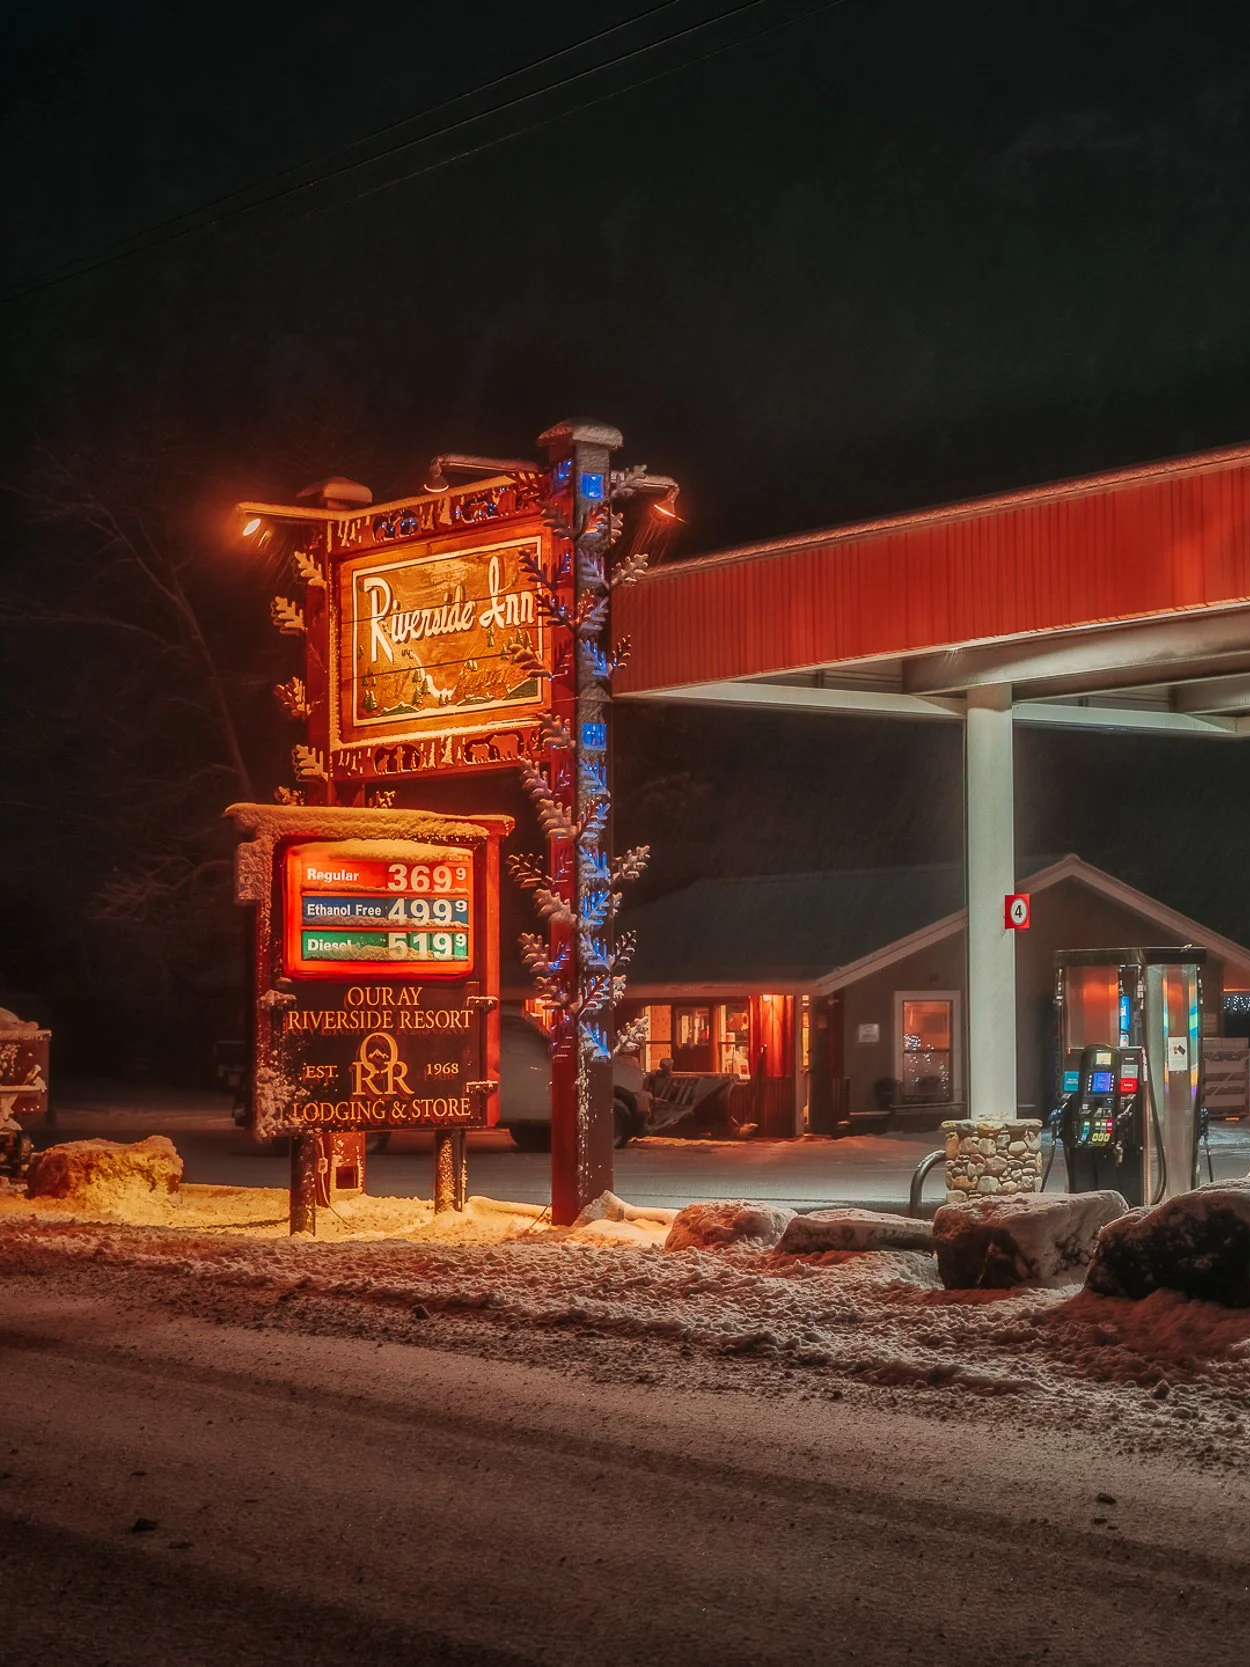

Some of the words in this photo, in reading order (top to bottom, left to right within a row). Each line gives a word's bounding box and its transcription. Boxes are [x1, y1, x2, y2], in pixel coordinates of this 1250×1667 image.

[363, 577, 477, 663] Riverside
[479, 556, 535, 629] Inn
[306, 867, 360, 883] Regular
[307, 904, 351, 916] Ethanol
[355, 904, 382, 916] Free
[1014, 904, 1023, 919] 4
[347, 986, 424, 1006] OURAY
[287, 1010, 394, 1030] RIVERSIDE
[399, 1009, 474, 1029] RESORT
[305, 1065, 339, 1079] EST.
[426, 1062, 460, 1075] 1968
[293, 1100, 386, 1122] LODGING
[391, 1099, 407, 1119] &
[411, 1097, 471, 1118] STORE
